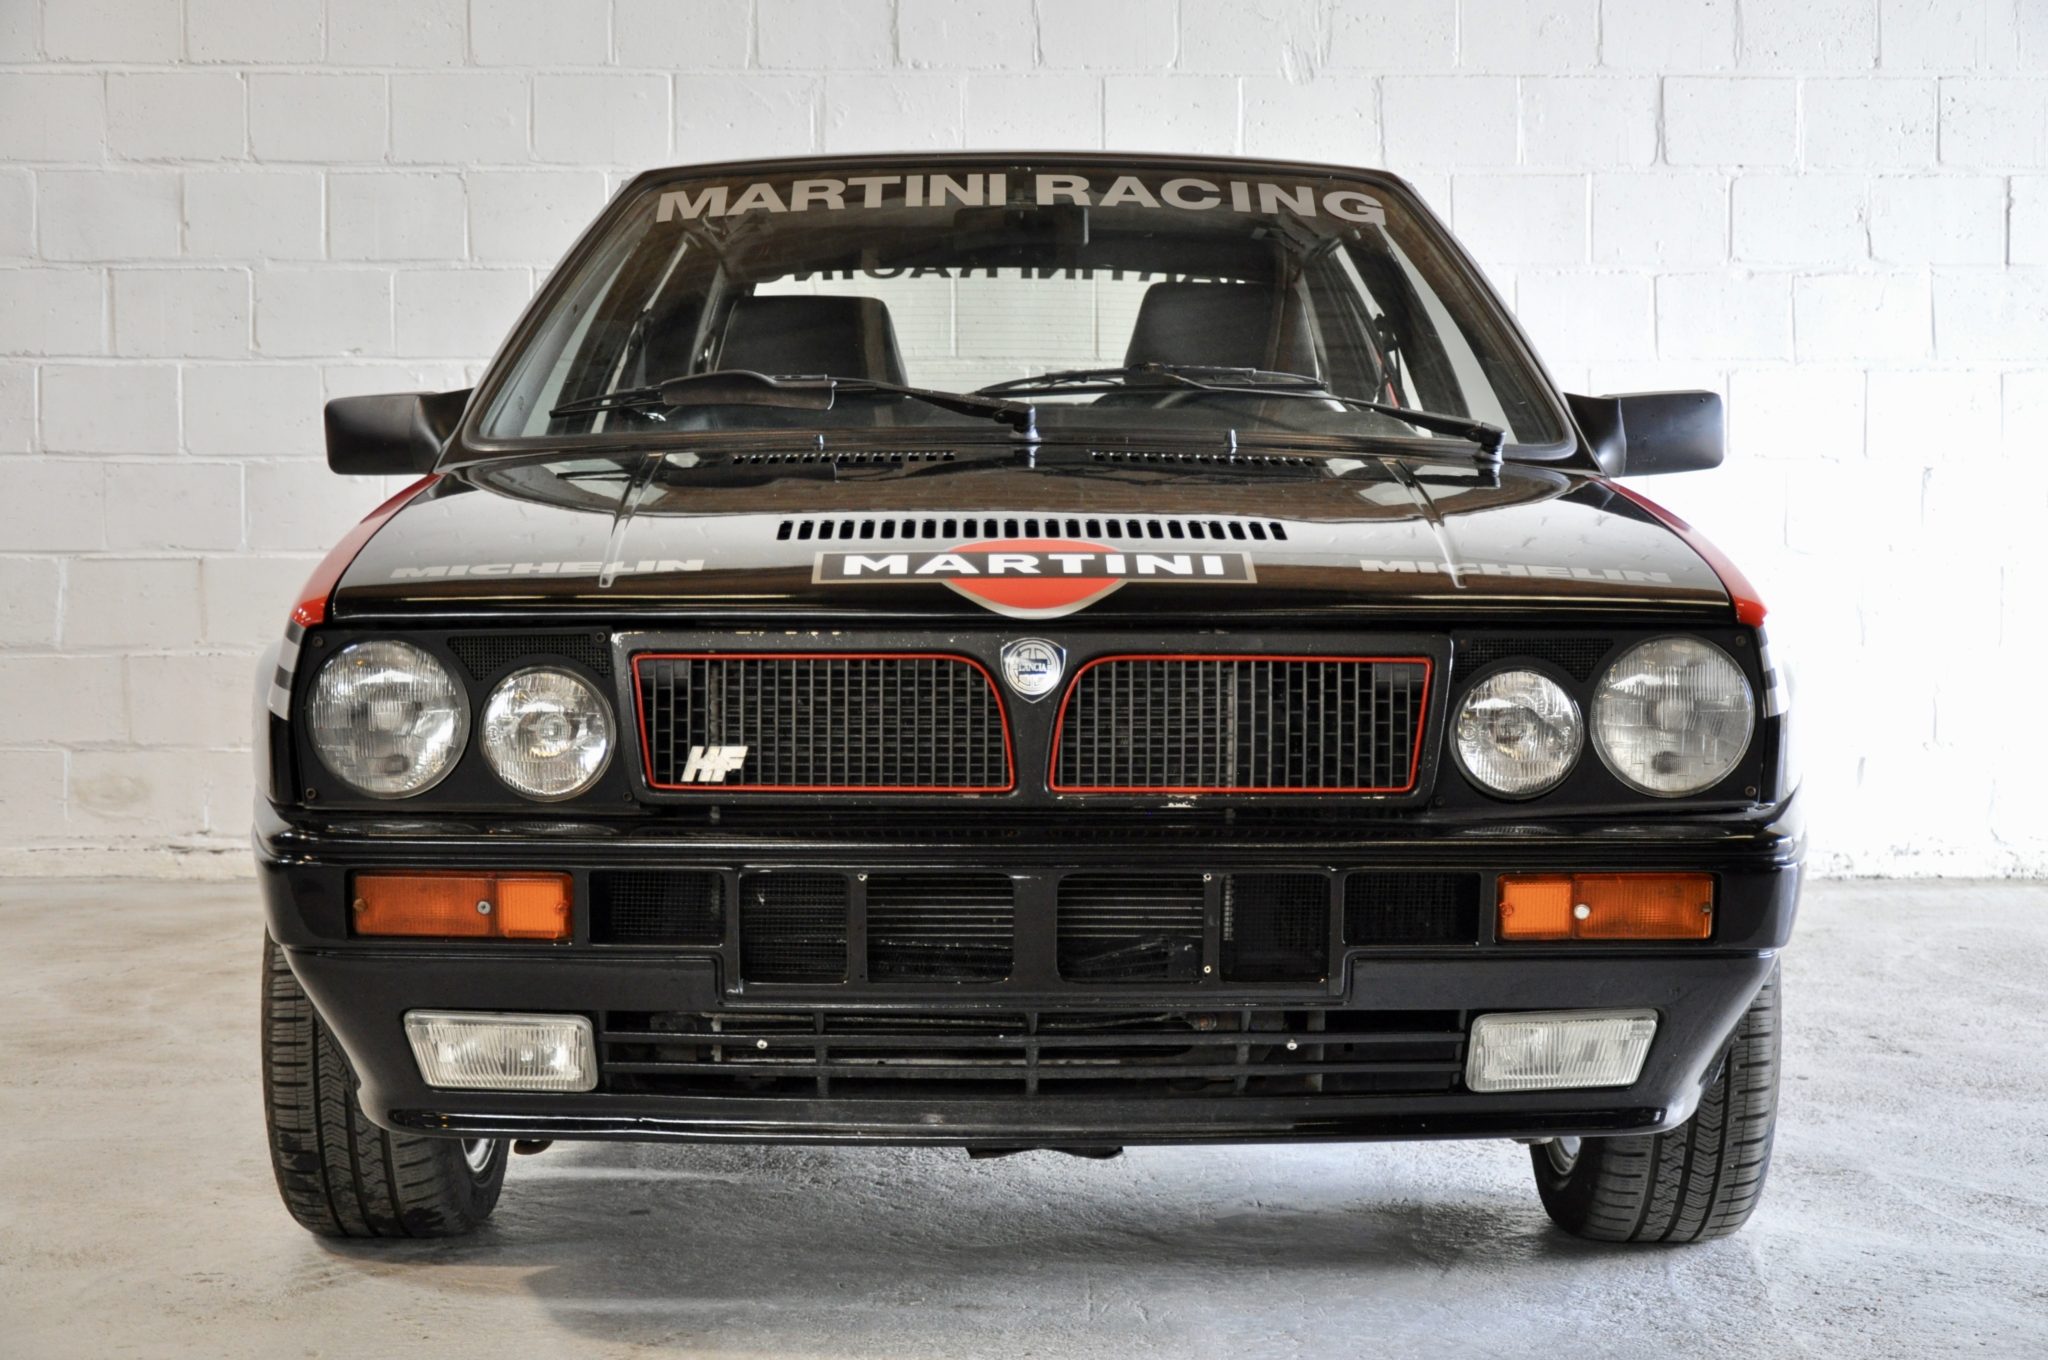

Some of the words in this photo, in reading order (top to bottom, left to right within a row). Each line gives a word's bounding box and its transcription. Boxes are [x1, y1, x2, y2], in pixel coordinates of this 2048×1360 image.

[656, 174, 1006, 222] MARTINI
[1035, 176, 1386, 225] RACING
[390, 560, 706, 579] MICHELIN
[842, 554, 1225, 576] MARTINI
[1361, 559, 1672, 582] MICHELIN
[681, 746, 748, 782] HF
